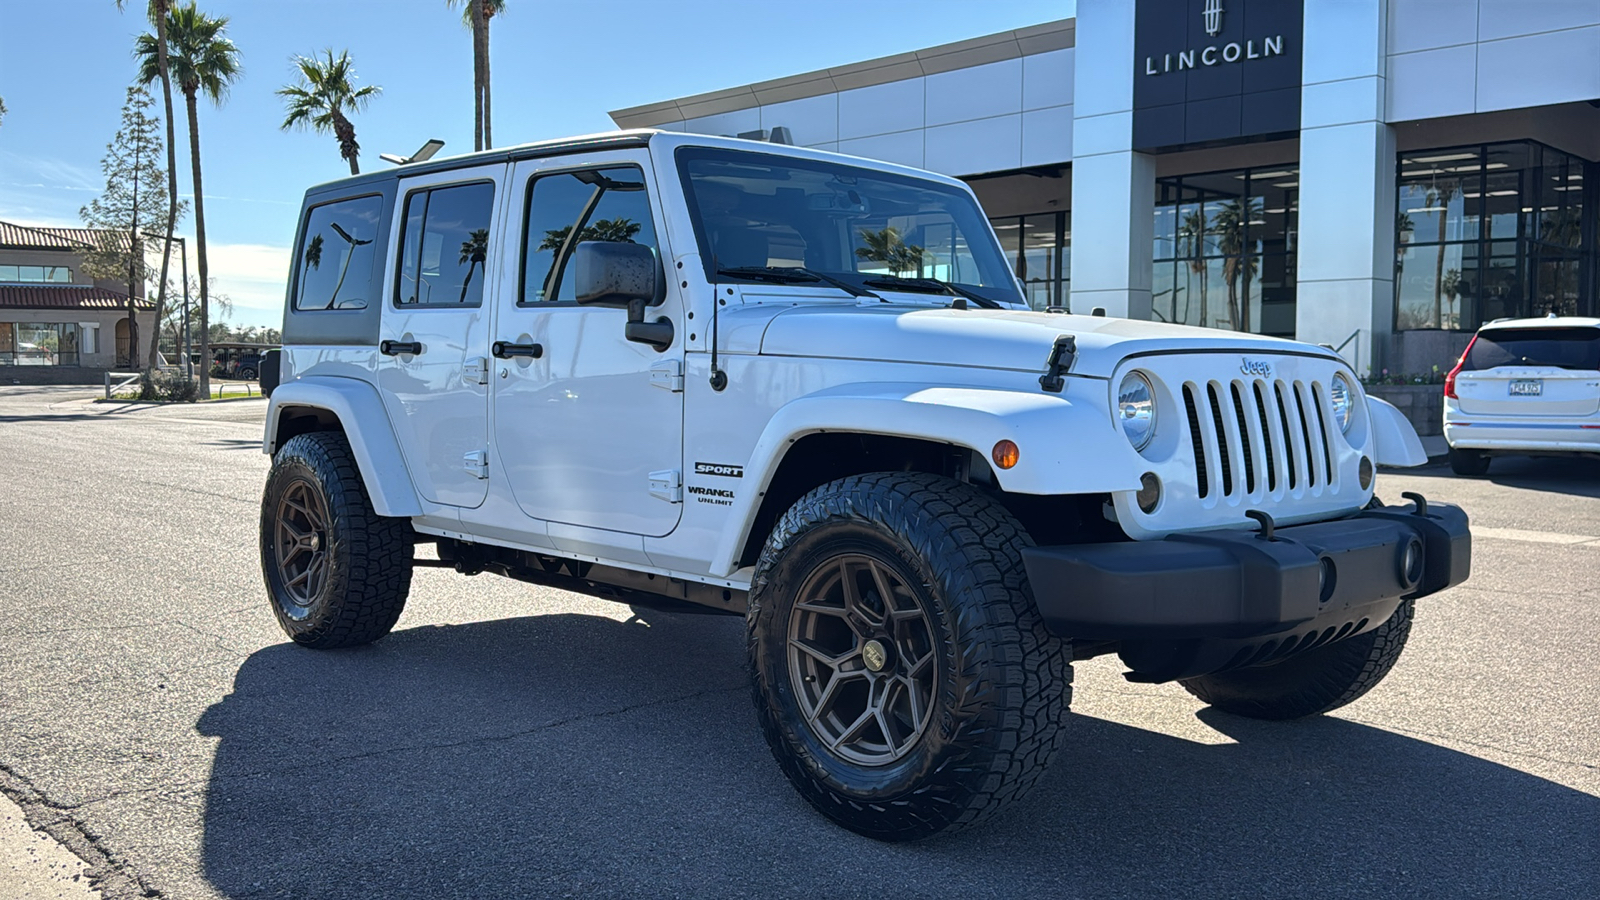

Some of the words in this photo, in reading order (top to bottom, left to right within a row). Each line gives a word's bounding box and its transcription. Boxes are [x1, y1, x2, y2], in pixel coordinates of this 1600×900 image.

[1145, 35, 1283, 75] LINCOLN
[1240, 357, 1271, 378] Jeep
[696, 463, 743, 476] SPORT
[688, 486, 735, 498] WRANGL
[697, 497, 733, 506] UNLIMIT
